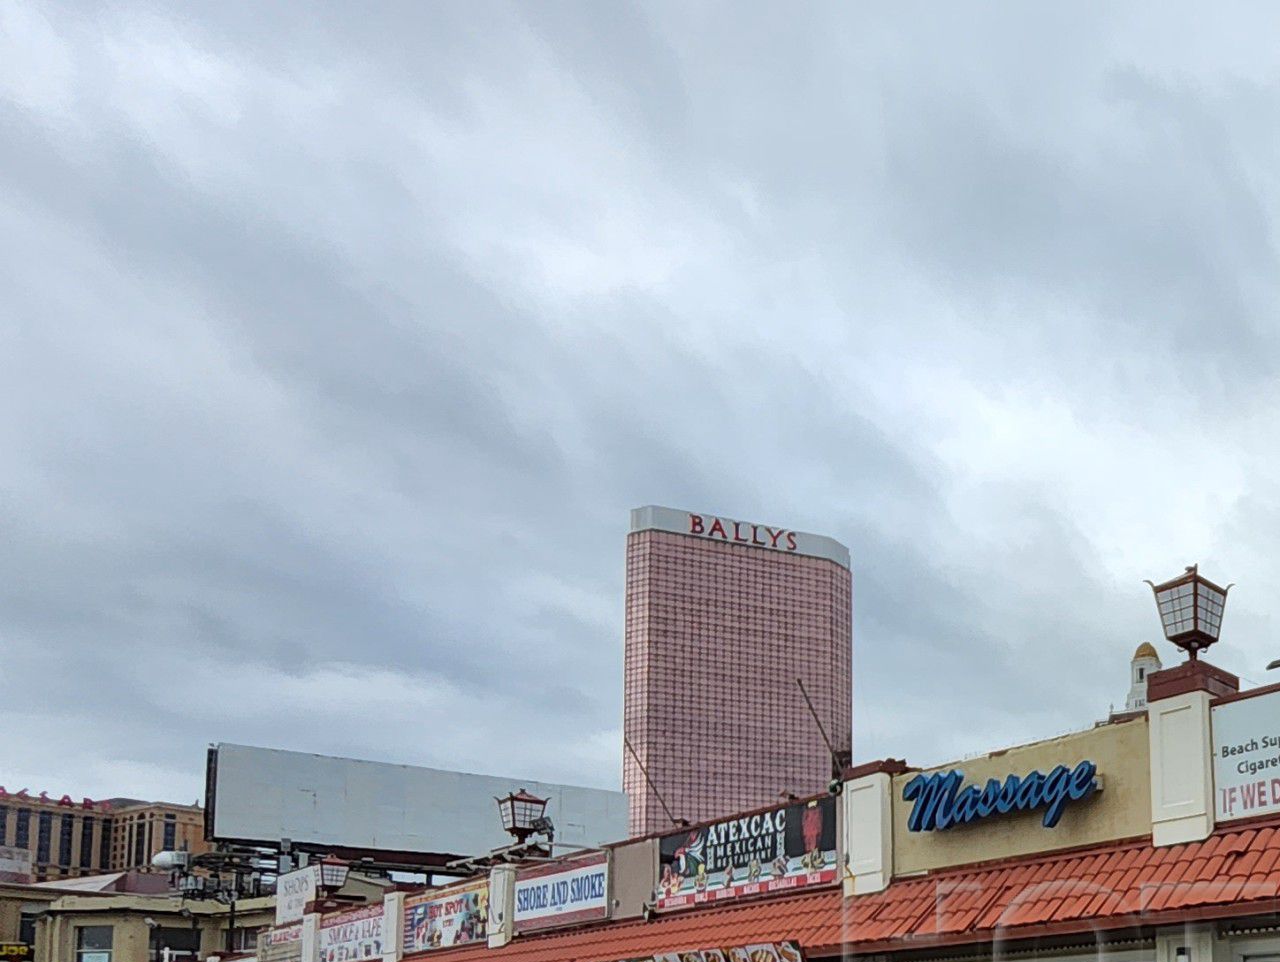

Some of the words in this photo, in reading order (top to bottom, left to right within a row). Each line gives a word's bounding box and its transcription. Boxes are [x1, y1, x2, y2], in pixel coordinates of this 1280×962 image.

[689, 513, 798, 551] BALLYS
[1221, 738, 1259, 758] Beach
[902, 760, 1097, 832] Massage
[1221, 787, 1238, 815] IF
[1240, 782, 1268, 811] WE
[706, 809, 786, 847] ATEXCAC
[716, 835, 772, 858] MEXICAN
[284, 875, 309, 896] SHOPS
[517, 884, 548, 912] SHORE
[549, 879, 569, 907] AND
[570, 873, 605, 903] SMOKE
[428, 904, 443, 919] HOT
[444, 899, 464, 917] SPOT
